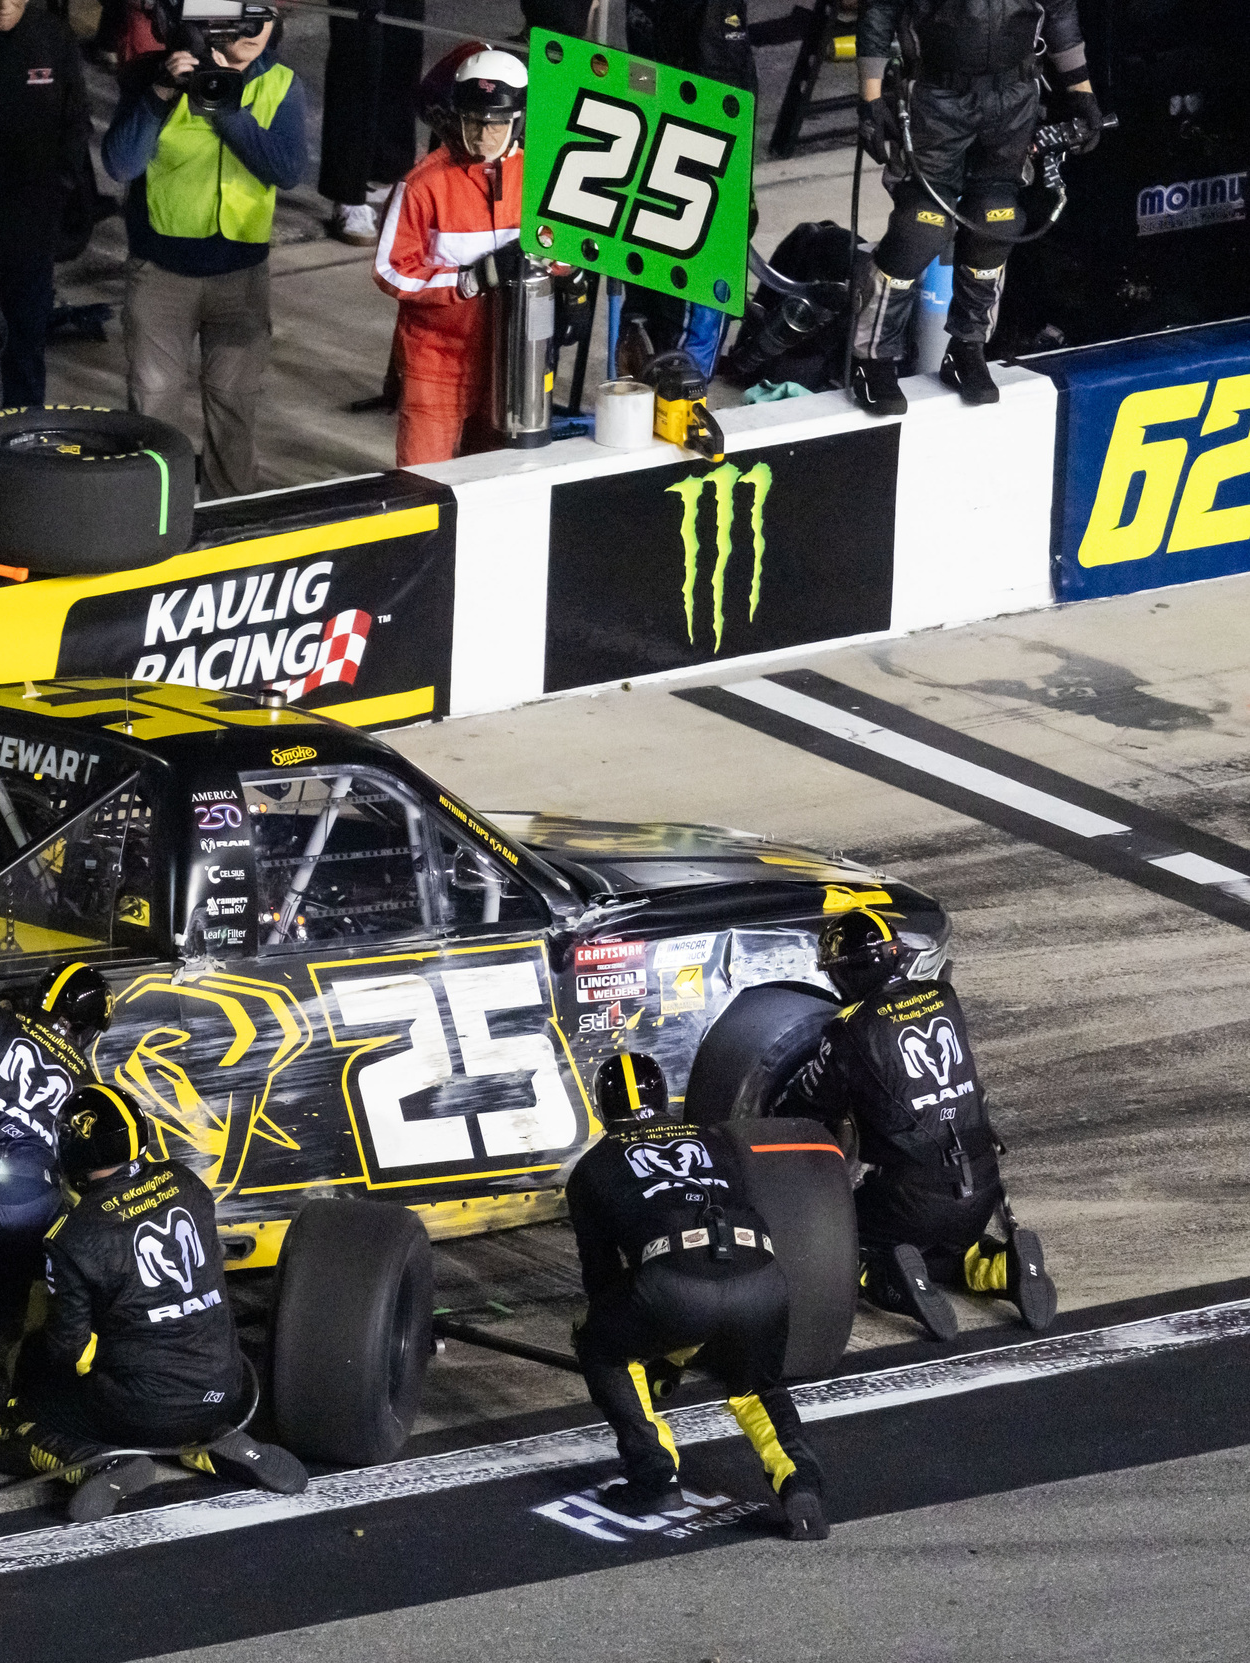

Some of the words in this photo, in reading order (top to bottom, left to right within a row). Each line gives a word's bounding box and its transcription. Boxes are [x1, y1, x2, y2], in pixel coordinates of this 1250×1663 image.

[540, 90, 735, 258] 25
[1078, 374, 1250, 568] 62
[144, 561, 334, 647] KAULIG
[131, 621, 323, 691] RACING
[271, 745, 318, 767] Smoke
[191, 790, 238, 802] AMERICA
[194, 802, 243, 831] 250
[439, 794, 468, 825] NOTHING
[467, 817, 490, 840] STOPS
[502, 846, 519, 867] RAM
[216, 839, 251, 848] RAM
[220, 869, 245, 878] CELSIUS
[217, 896, 249, 908] campers
[577, 944, 643, 962] CRAFTSMAN
[671, 939, 708, 951] NASCAR
[580, 973, 635, 989] LINCOLN
[593, 986, 641, 1000] WELDERS
[331, 960, 577, 1169] 25
[911, 1080, 975, 1112] RAM
[147, 1289, 223, 1323] RAM
